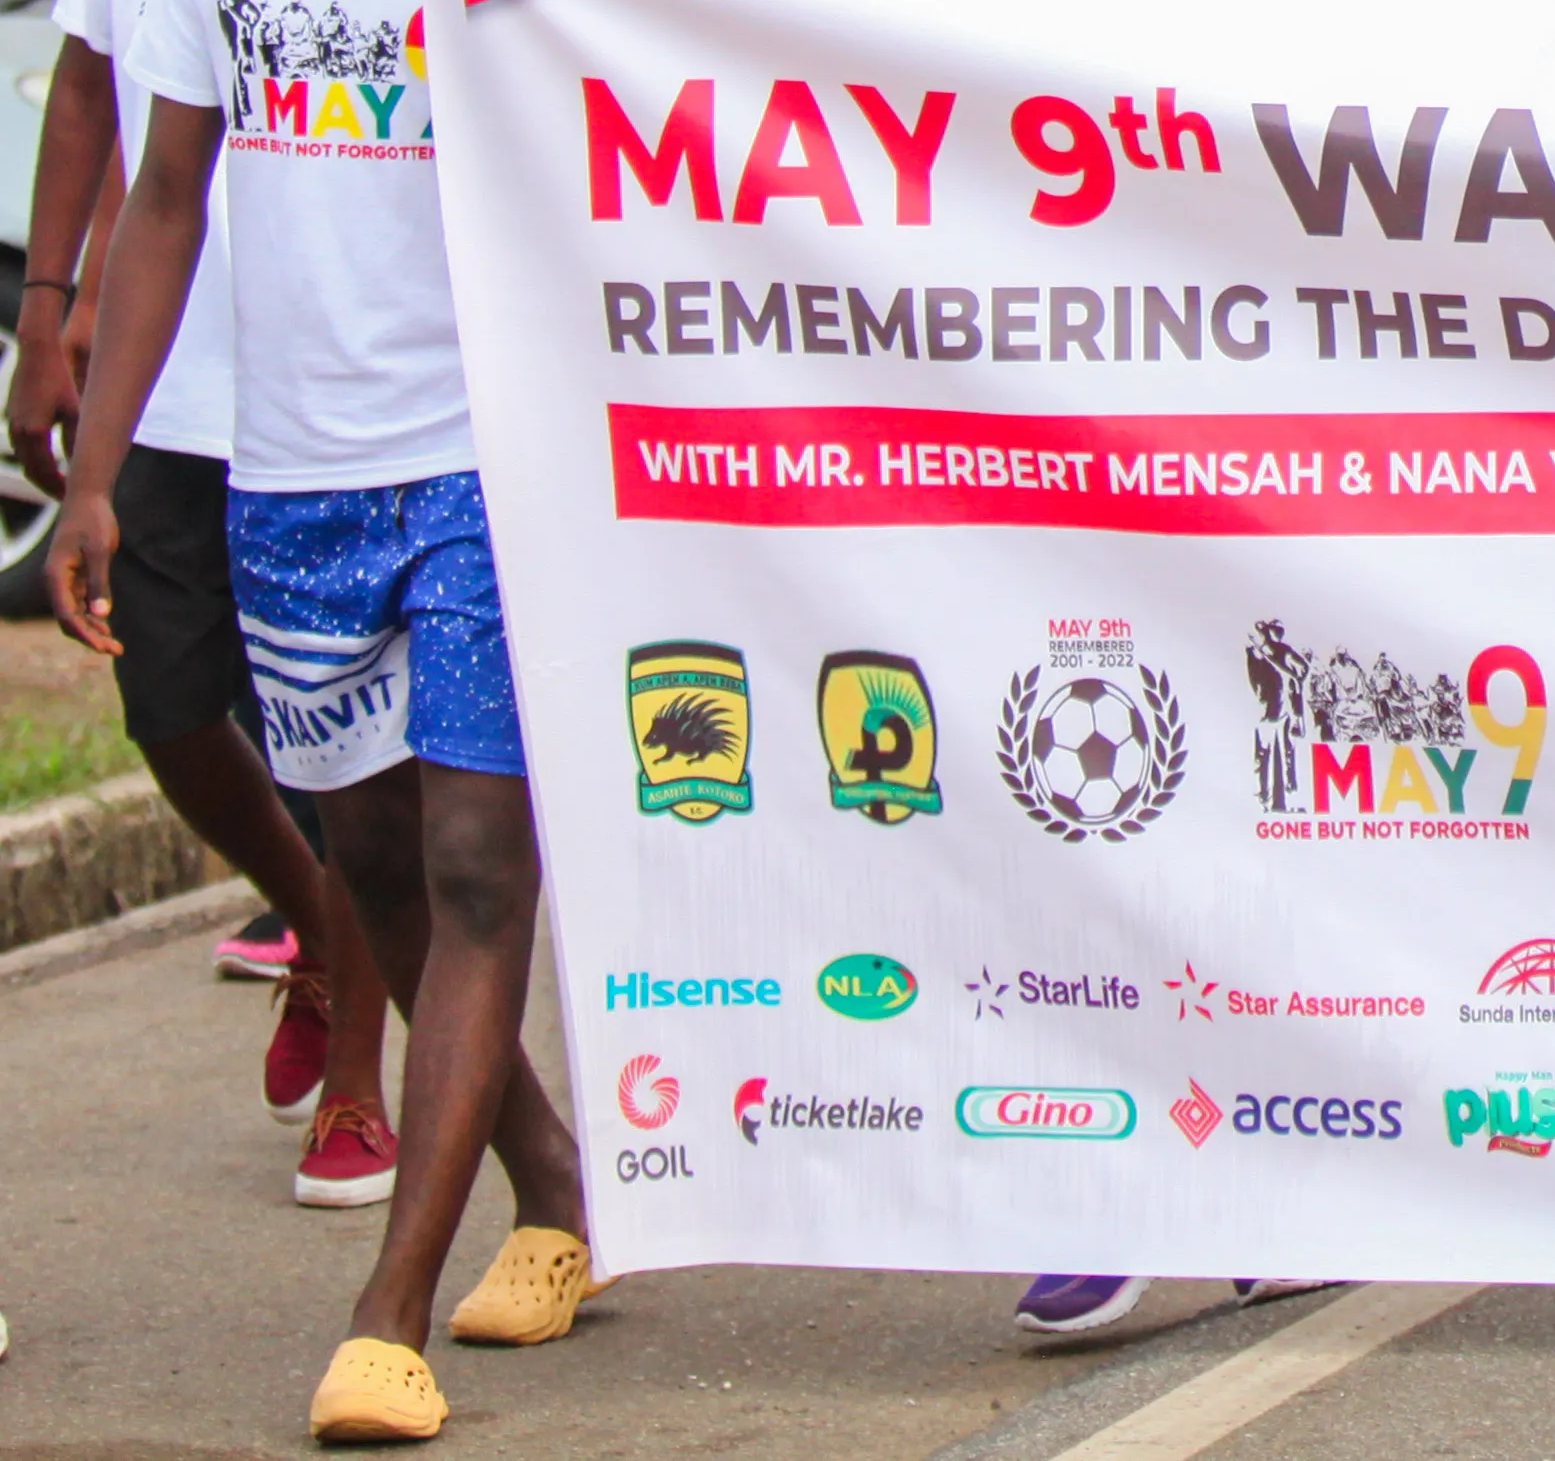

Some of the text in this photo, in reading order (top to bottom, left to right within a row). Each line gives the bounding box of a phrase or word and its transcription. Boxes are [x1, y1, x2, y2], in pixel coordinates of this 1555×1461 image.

[263, 77, 407, 141] MAY
[228, 136, 268, 151] GONE
[270, 141, 291, 156] BUT
[296, 143, 333, 158] NOT
[582, 77, 957, 227] MAY
[1011, 88, 1222, 228] 9th
[602, 281, 1271, 362] REMEMBERING
[1296, 288, 1477, 360] THE
[637, 440, 759, 488] WITH
[774, 442, 864, 490] MR.
[877, 443, 1095, 493] HERBERT
[1109, 450, 1323, 496] MENSAH
[1340, 452, 1374, 496] &
[1388, 449, 1536, 495] NANA
[1048, 618, 1132, 639] MAY 9th
[1049, 640, 1135, 653] REMEMBERED
[1050, 654, 1084, 669] 2001
[1098, 654, 1135, 669] 2022
[1311, 644, 1548, 816] MAY 9
[1256, 821, 1531, 841] GONE BUT NOT FORGOTTEN
[606, 971, 783, 1012] Hisense
[823, 975, 902, 999] NLA
[1018, 970, 1140, 1010] StarLife
[1227, 990, 1426, 1017] Star Assurance
[1459, 1004, 1514, 1024] Sunda
[769, 1094, 925, 1131] ticketlake
[996, 1092, 1094, 1128] Gino
[1233, 1093, 1403, 1139] access
[616, 1145, 695, 1184] GOIL
